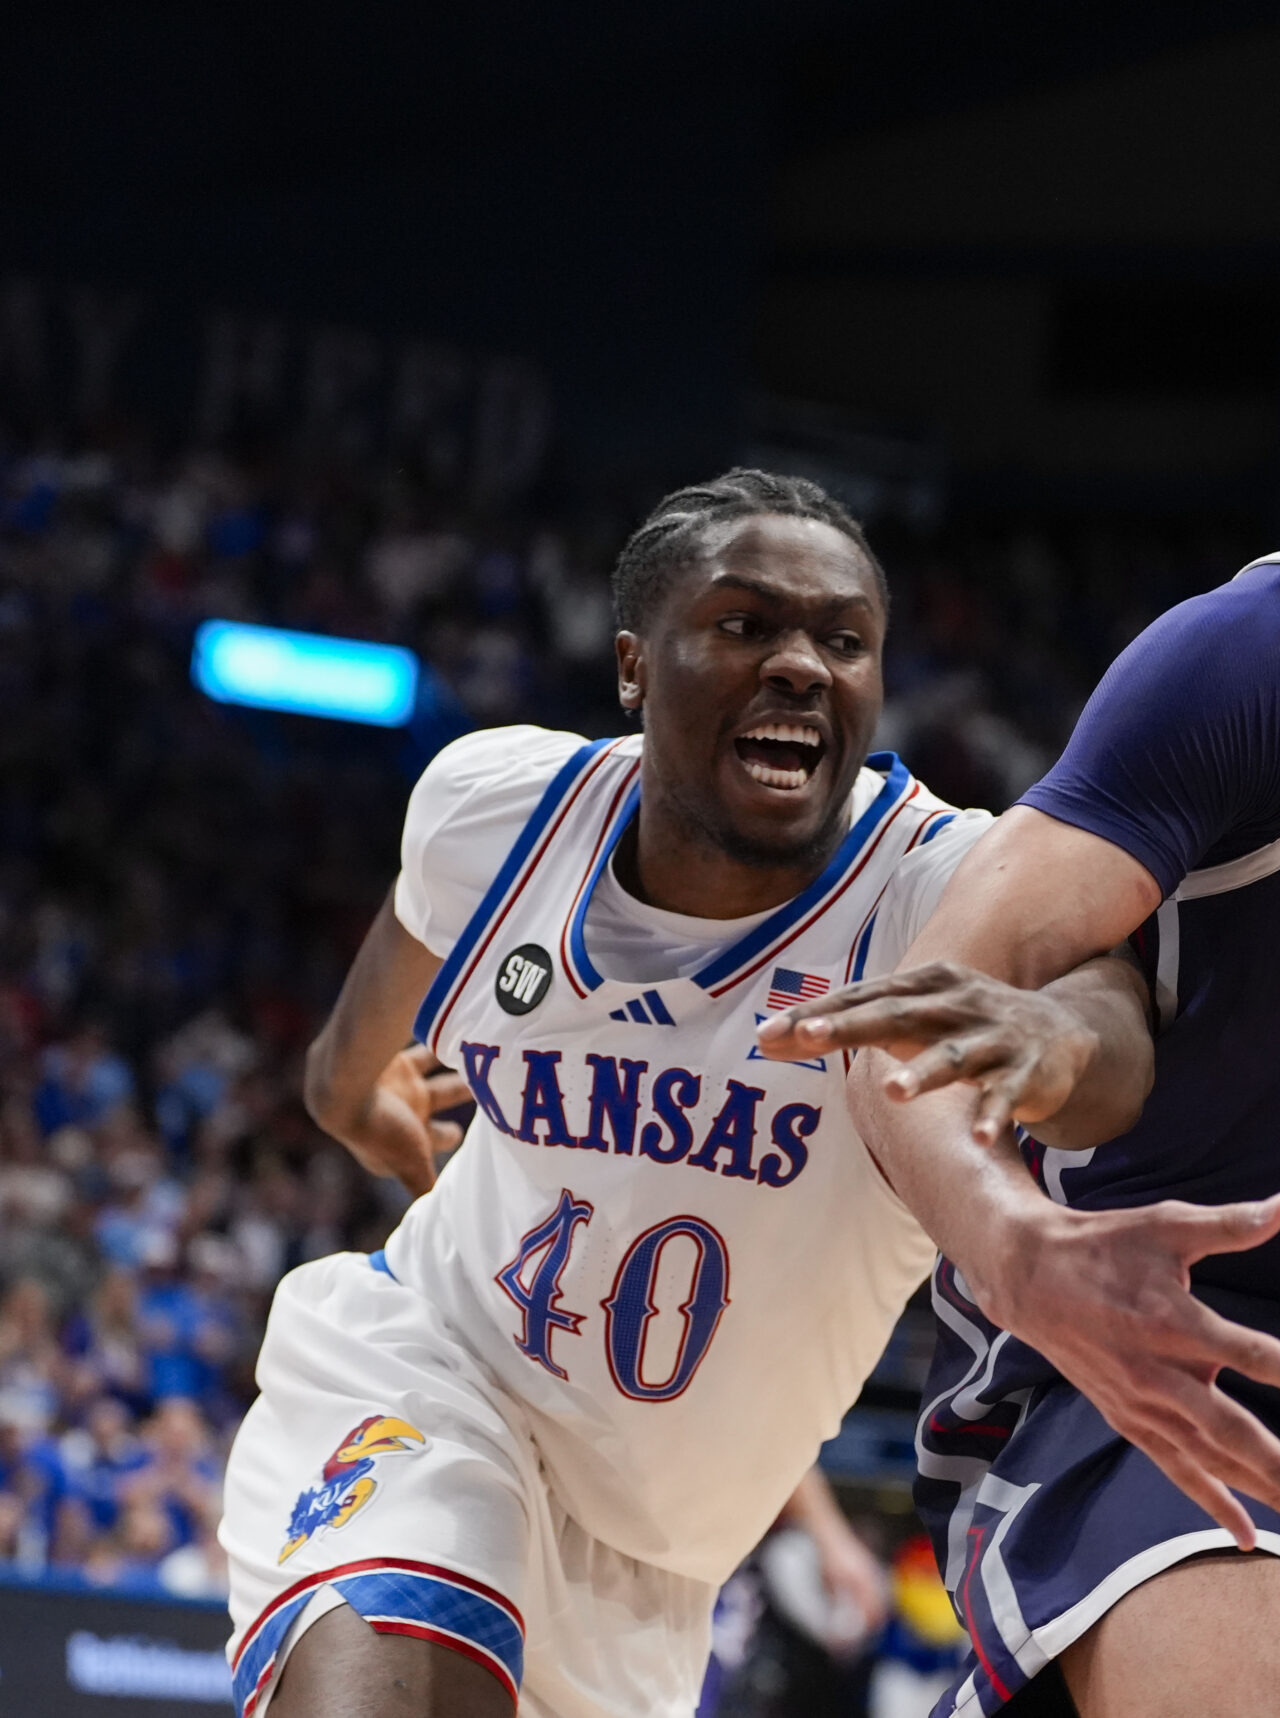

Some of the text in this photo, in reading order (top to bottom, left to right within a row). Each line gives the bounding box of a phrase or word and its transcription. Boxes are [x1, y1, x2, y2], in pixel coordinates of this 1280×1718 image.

[499, 954, 548, 1004] SW
[460, 1041, 822, 1188] KANSAS
[494, 1188, 731, 1403] 40
[307, 1482, 342, 1517] KU
